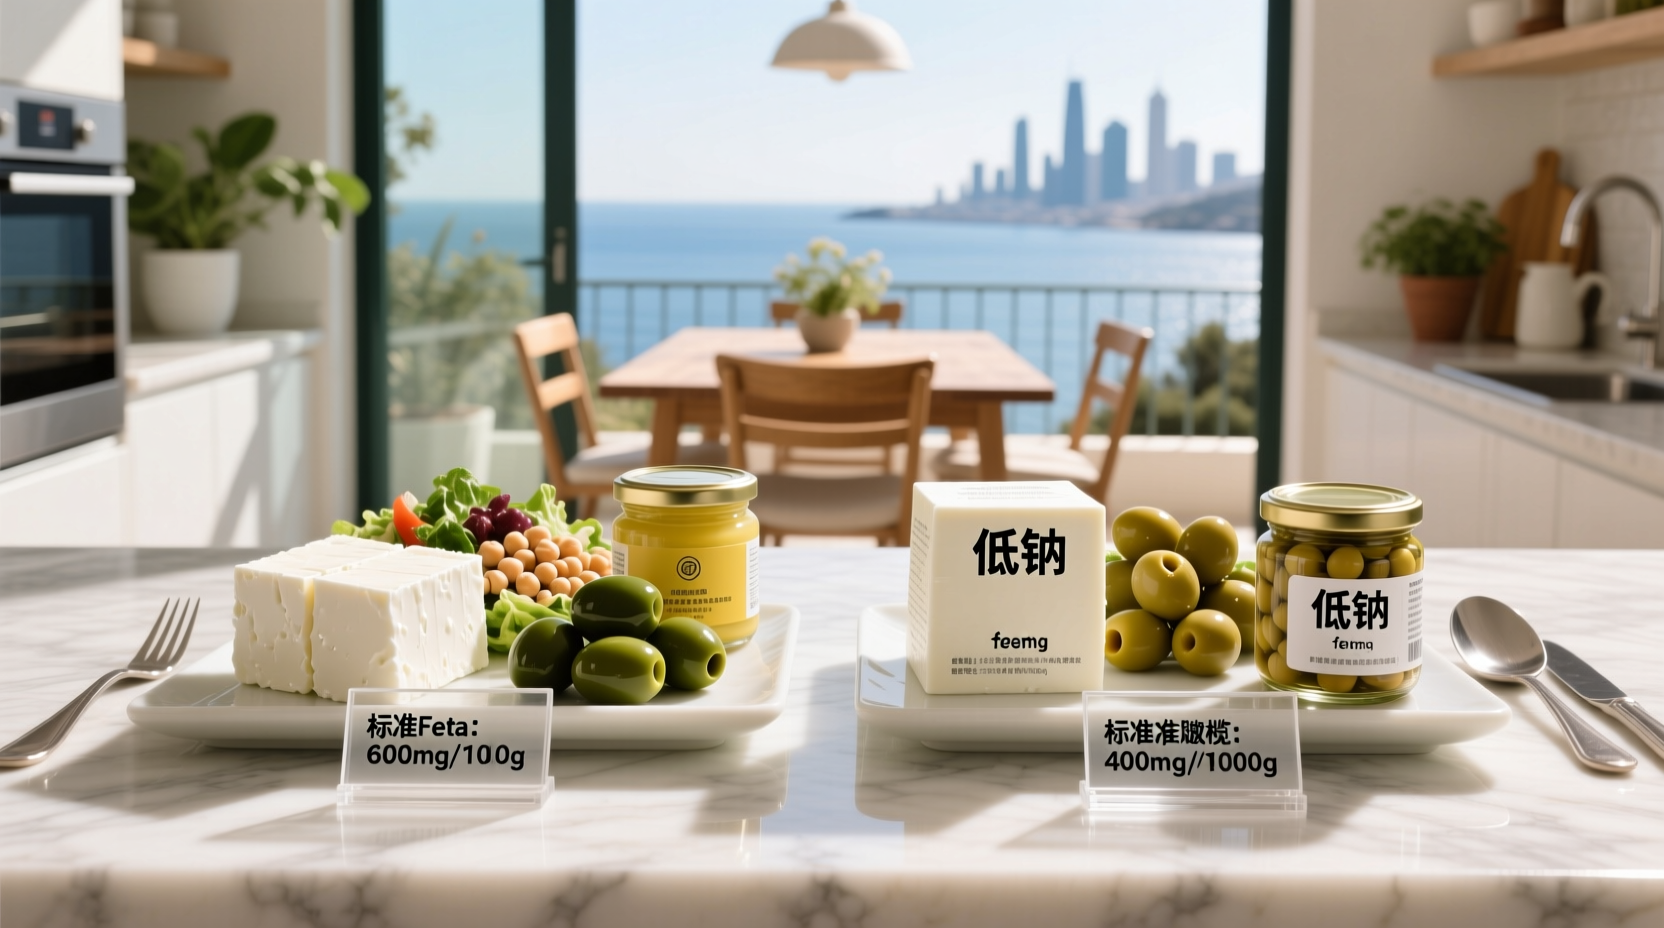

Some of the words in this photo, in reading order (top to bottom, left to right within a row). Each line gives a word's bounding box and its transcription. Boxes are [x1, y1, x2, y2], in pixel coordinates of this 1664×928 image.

[972, 528, 1066, 576] 低钠
[1311, 589, 1389, 630] 低钠
[366, 744, 526, 771] 600mg/100g
